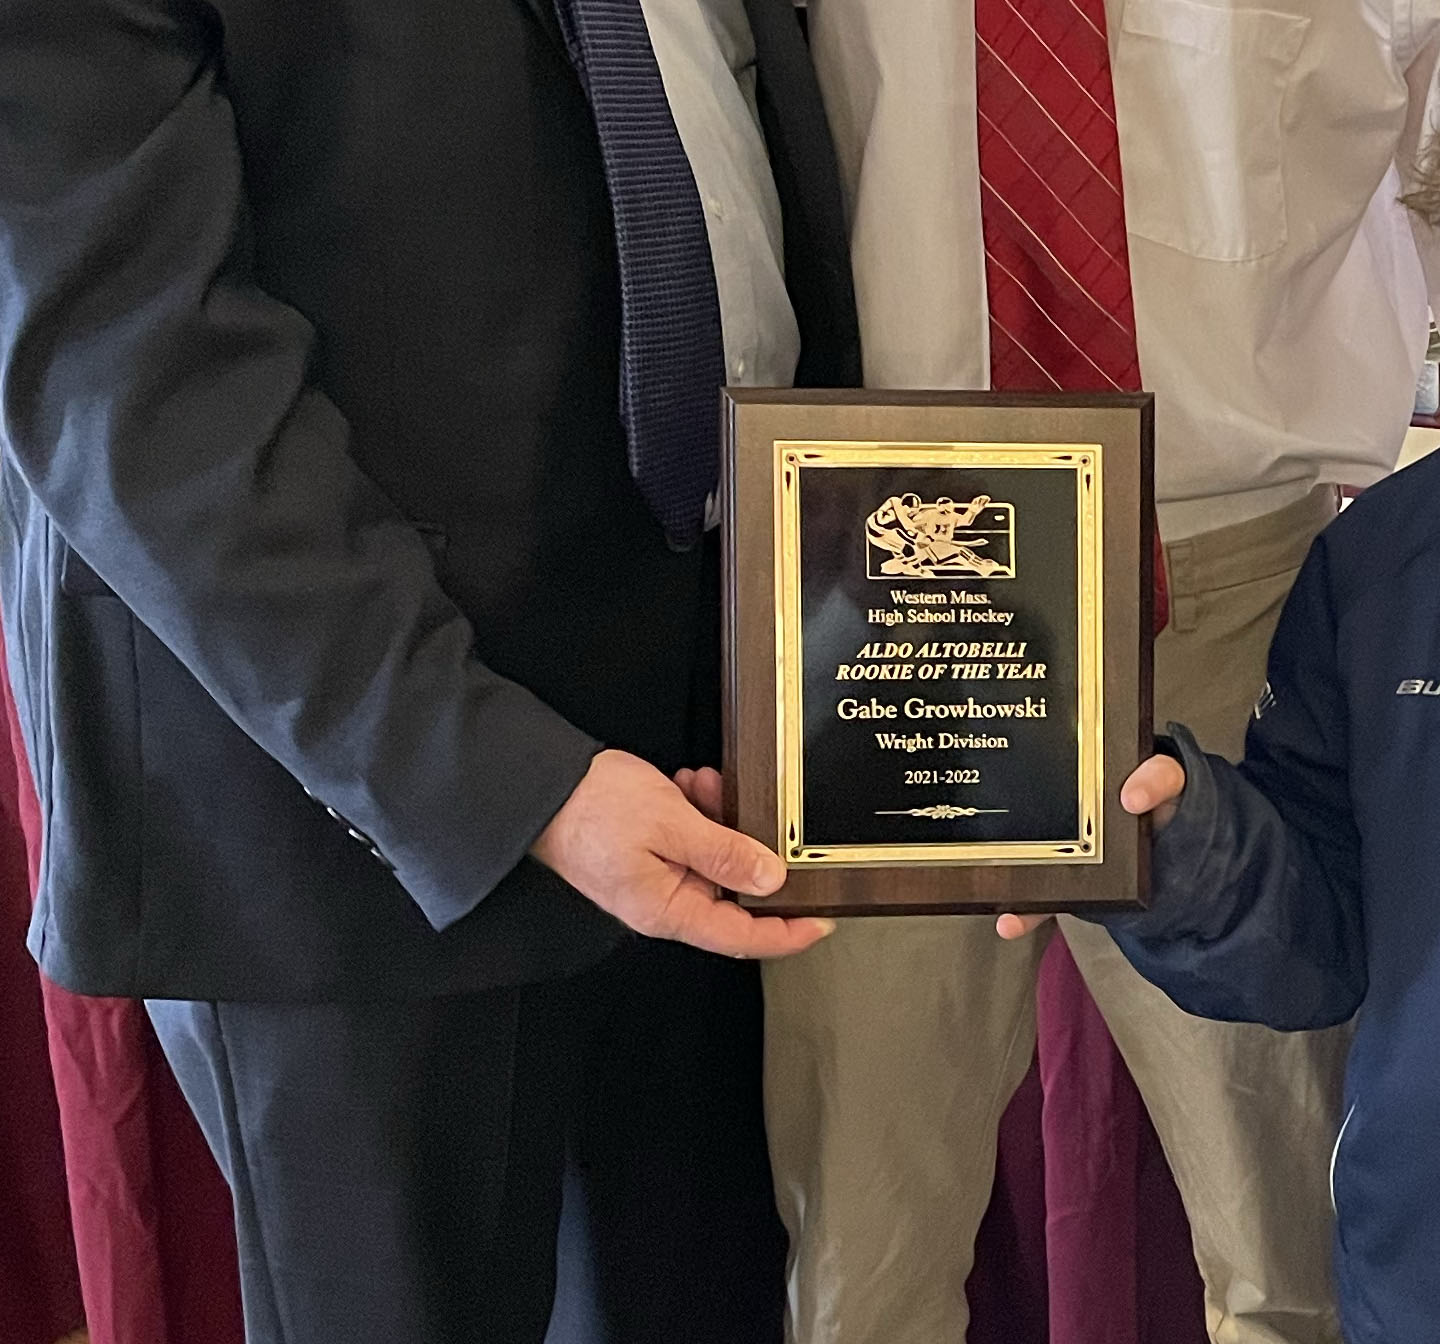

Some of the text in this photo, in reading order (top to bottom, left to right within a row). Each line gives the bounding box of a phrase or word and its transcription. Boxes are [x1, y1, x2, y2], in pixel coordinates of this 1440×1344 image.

[890, 589, 992, 605] Western Mass.
[868, 608, 1014, 626] High School Hockey
[856, 642, 1028, 659] ALDO ALTOBELLI
[835, 663, 1047, 681] ROOKIE OF THE YEAR
[837, 696, 1048, 720] Gabe Growhowski
[875, 732, 1009, 753] Wright Division
[904, 769, 981, 785] 2021-2022
